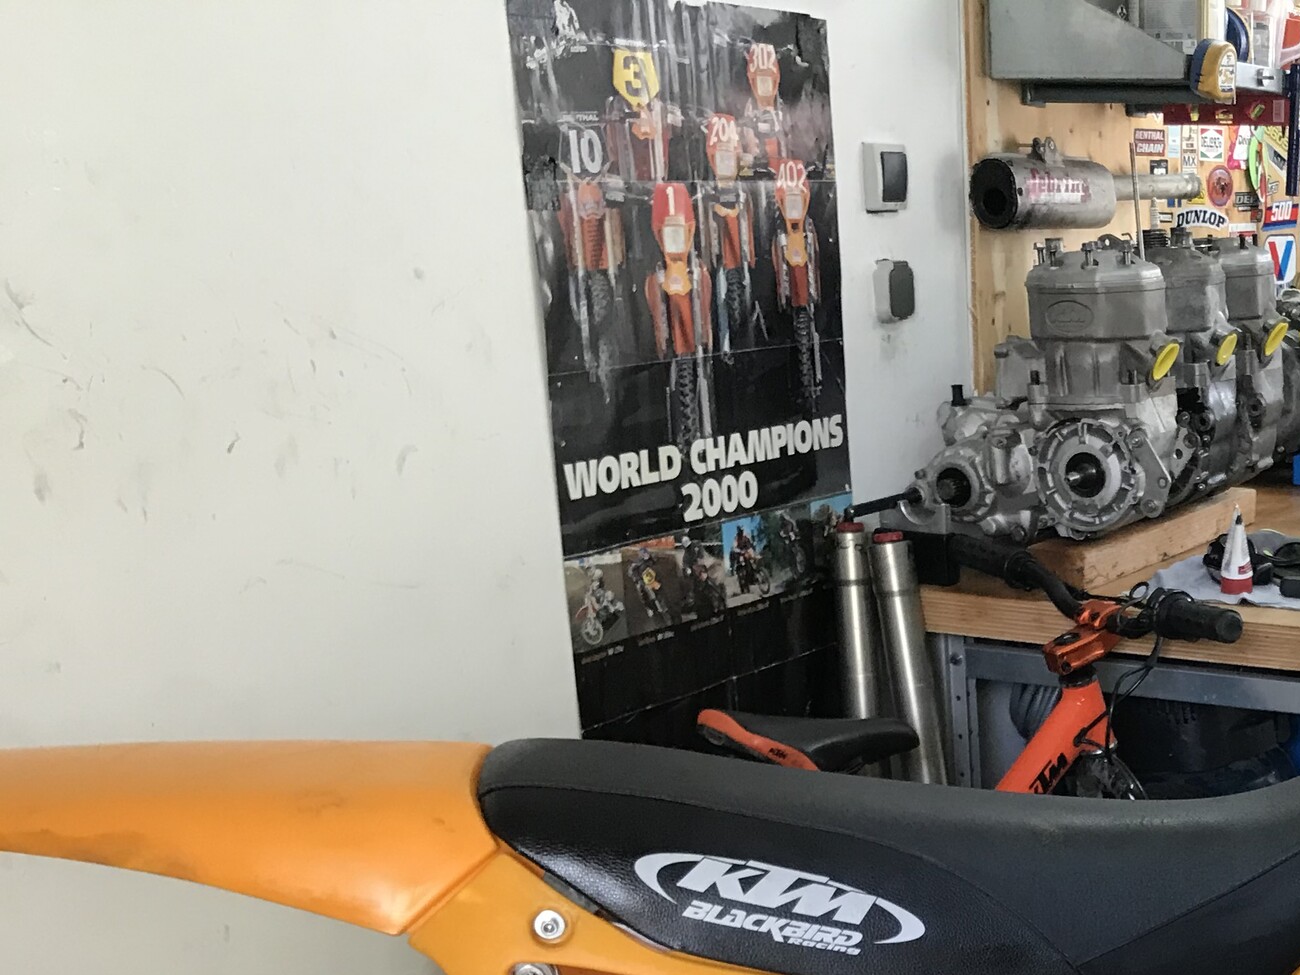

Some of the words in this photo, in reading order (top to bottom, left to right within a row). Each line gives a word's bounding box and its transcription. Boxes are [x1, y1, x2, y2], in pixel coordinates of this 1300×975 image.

[750, 43, 777, 73] 302
[623, 55, 651, 97] 3
[709, 117, 740, 146] 204
[1135, 130, 1165, 141] RENTHAL
[568, 129, 603, 174] 10
[1136, 142, 1164, 154] CHAIN
[1183, 155, 1197, 167] MX
[777, 160, 807, 193] 402
[666, 186, 675, 216] 1
[1271, 201, 1293, 222] 500
[1176, 209, 1226, 229] DUNLOP
[563, 444, 682, 501] WORLD
[689, 414, 844, 475] CHAMPIONS
[681, 470, 759, 523] 2000
[1028, 752, 1069, 794] TM
[676, 856, 878, 926] KTM
[682, 900, 864, 947] BLACKBIRD
[787, 937, 862, 956] Racing
